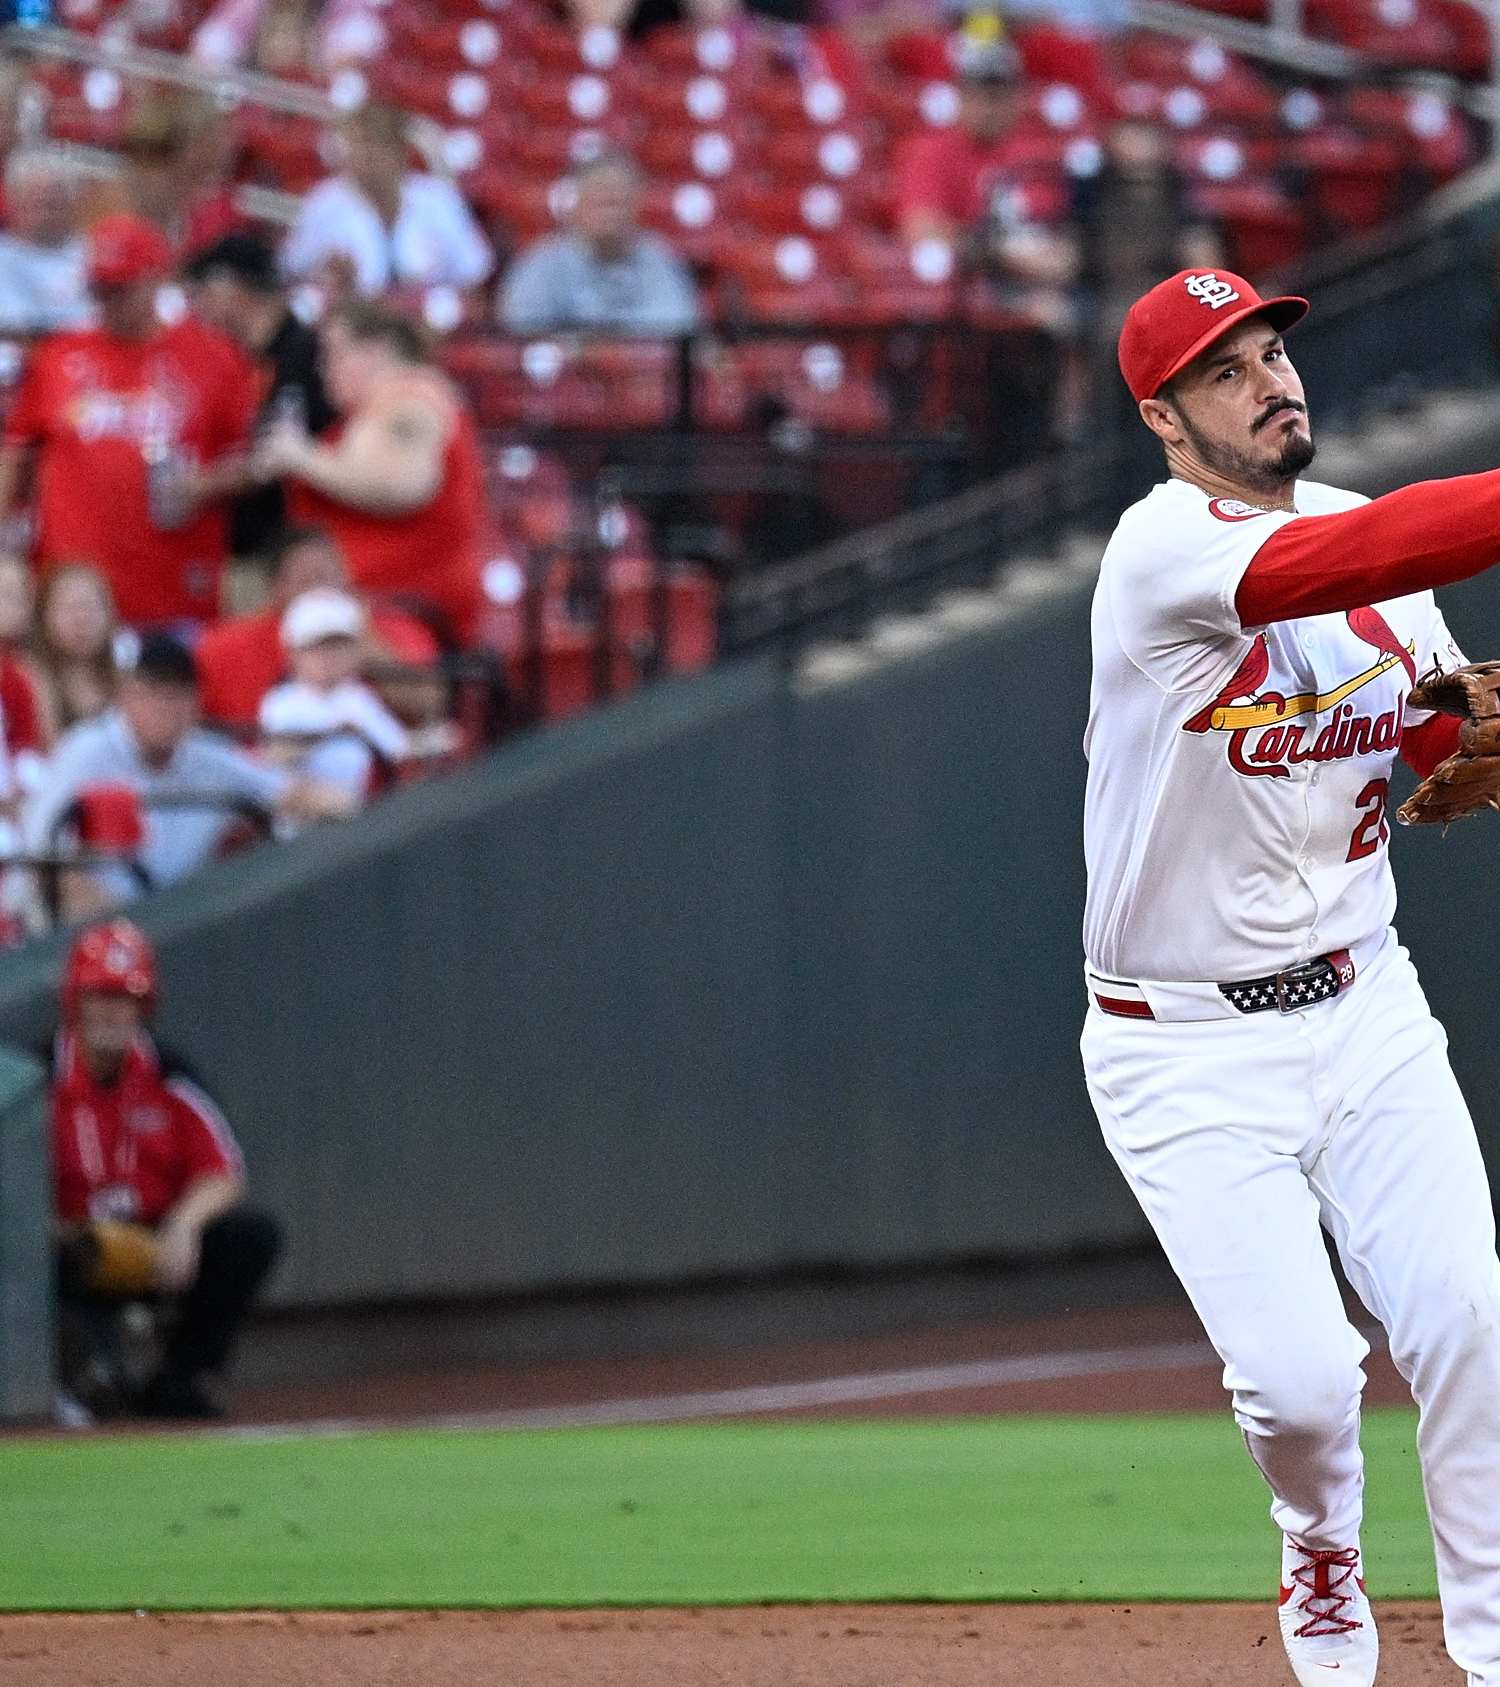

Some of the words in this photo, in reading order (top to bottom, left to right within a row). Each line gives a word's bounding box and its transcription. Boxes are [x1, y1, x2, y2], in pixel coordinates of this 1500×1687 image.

[1227, 689, 1403, 779] Cardinal
[1344, 777, 1389, 864] 2
[1340, 964, 1353, 984] 28
